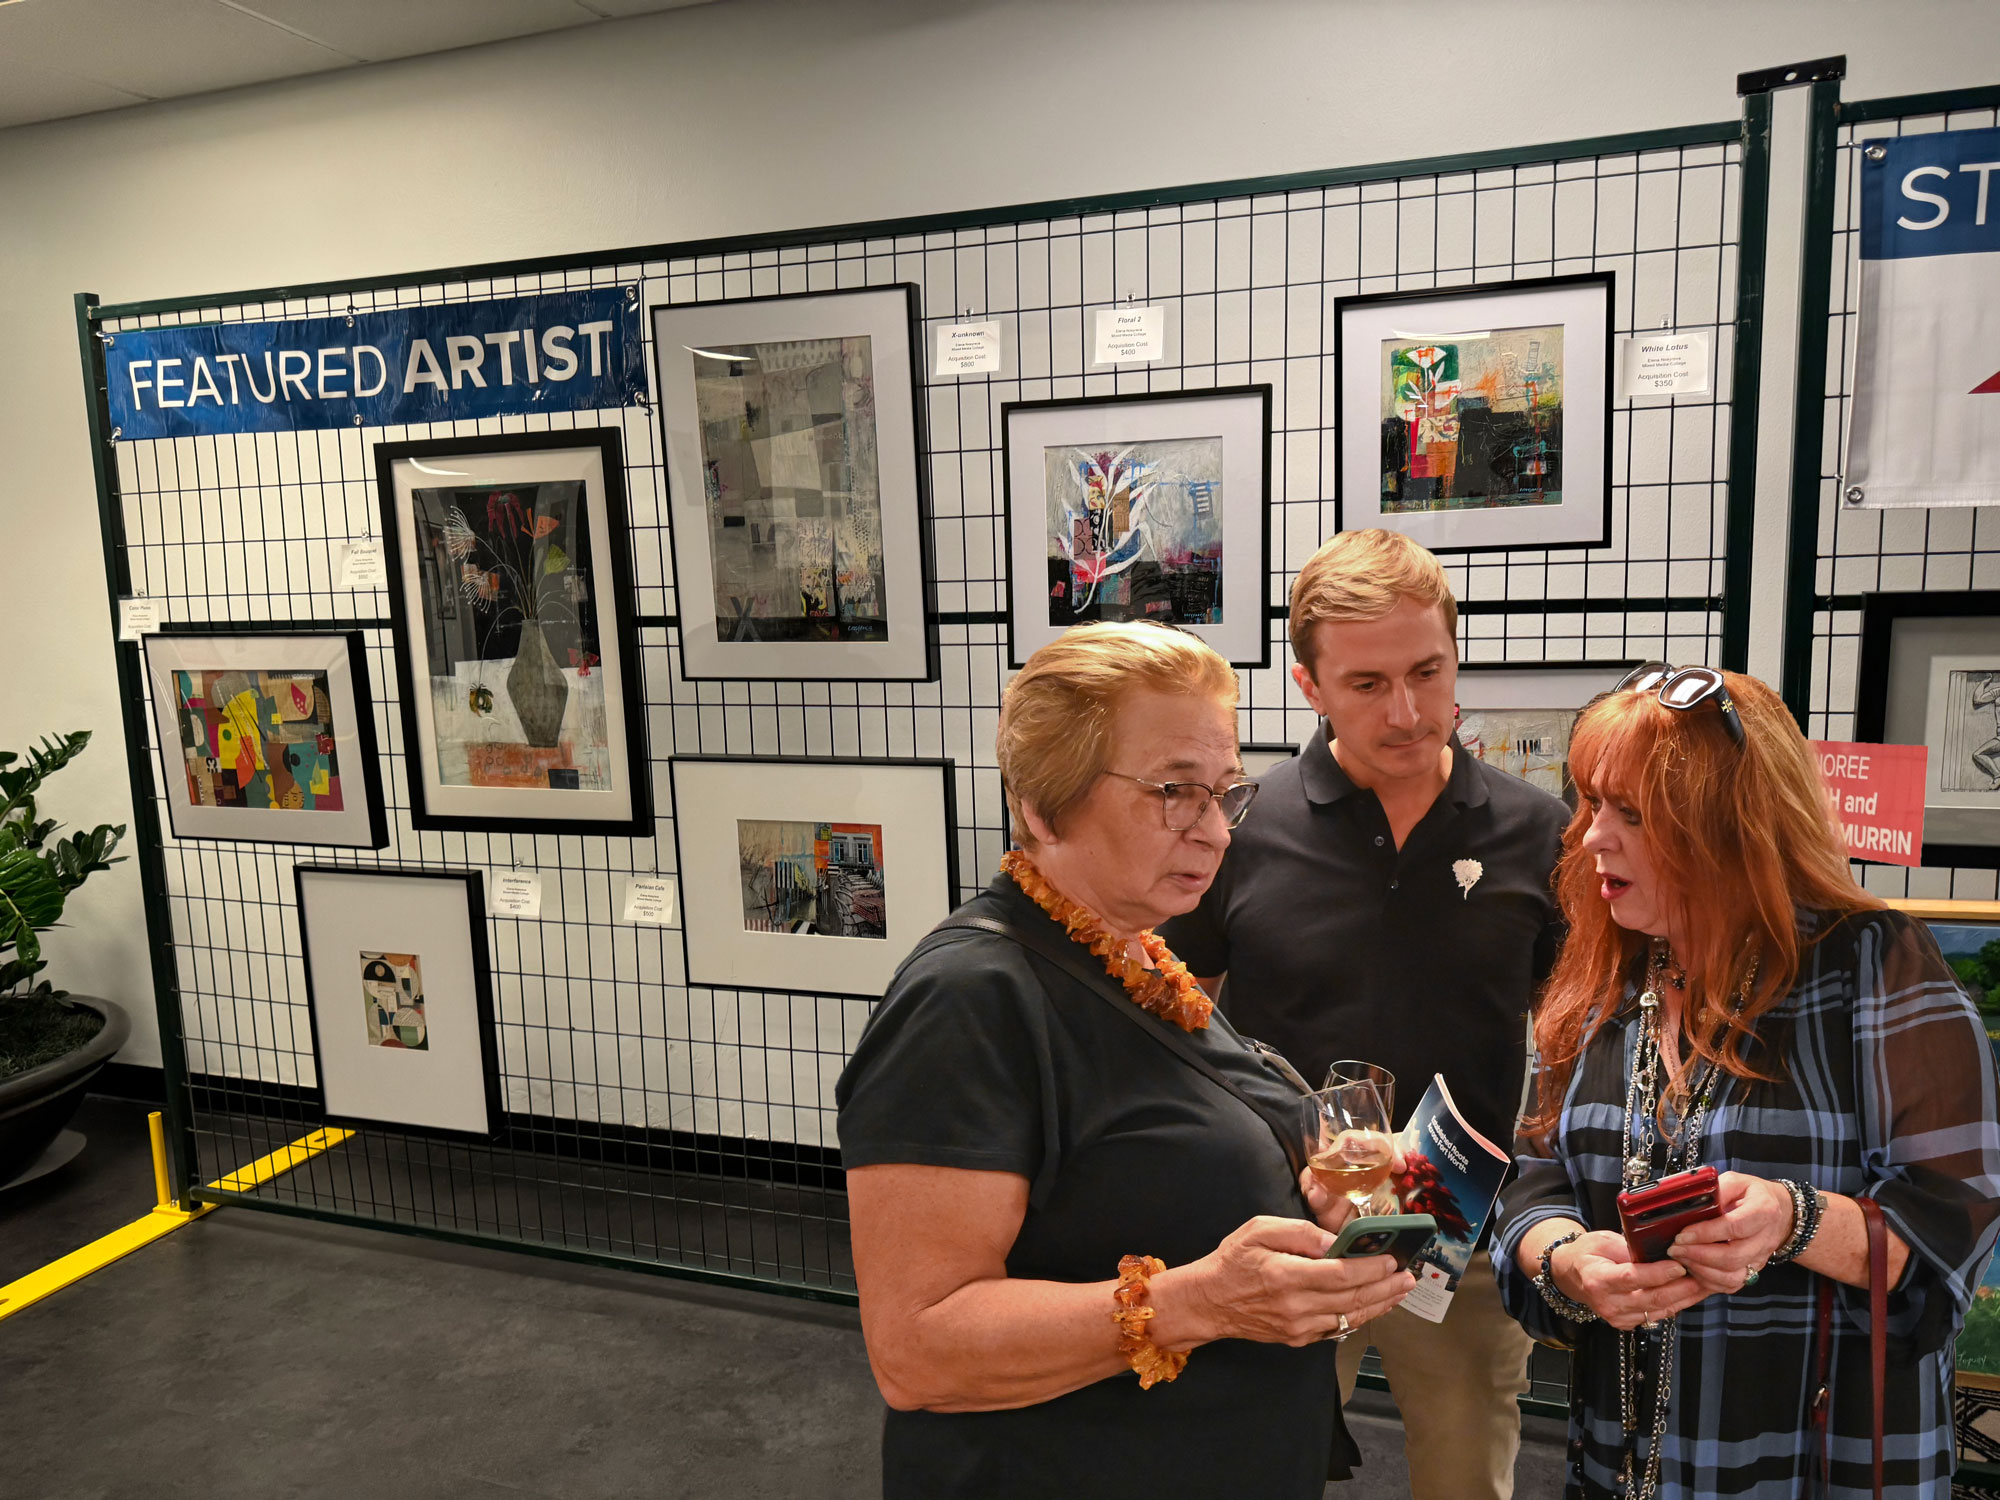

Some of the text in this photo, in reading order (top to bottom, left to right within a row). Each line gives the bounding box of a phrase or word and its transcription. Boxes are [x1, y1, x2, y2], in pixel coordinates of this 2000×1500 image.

[1117, 316, 1136, 324] Floral
[1641, 345, 1664, 353] White
[129, 320, 613, 411] FEATURED ARTIST
[1654, 379, 1673, 388] $350
[1844, 792, 1878, 816] and
[1841, 823, 1912, 856] MURRIN
[1427, 1122, 1467, 1174] Across Fort Worth.
[1431, 1114, 1469, 1165] Established Roots
